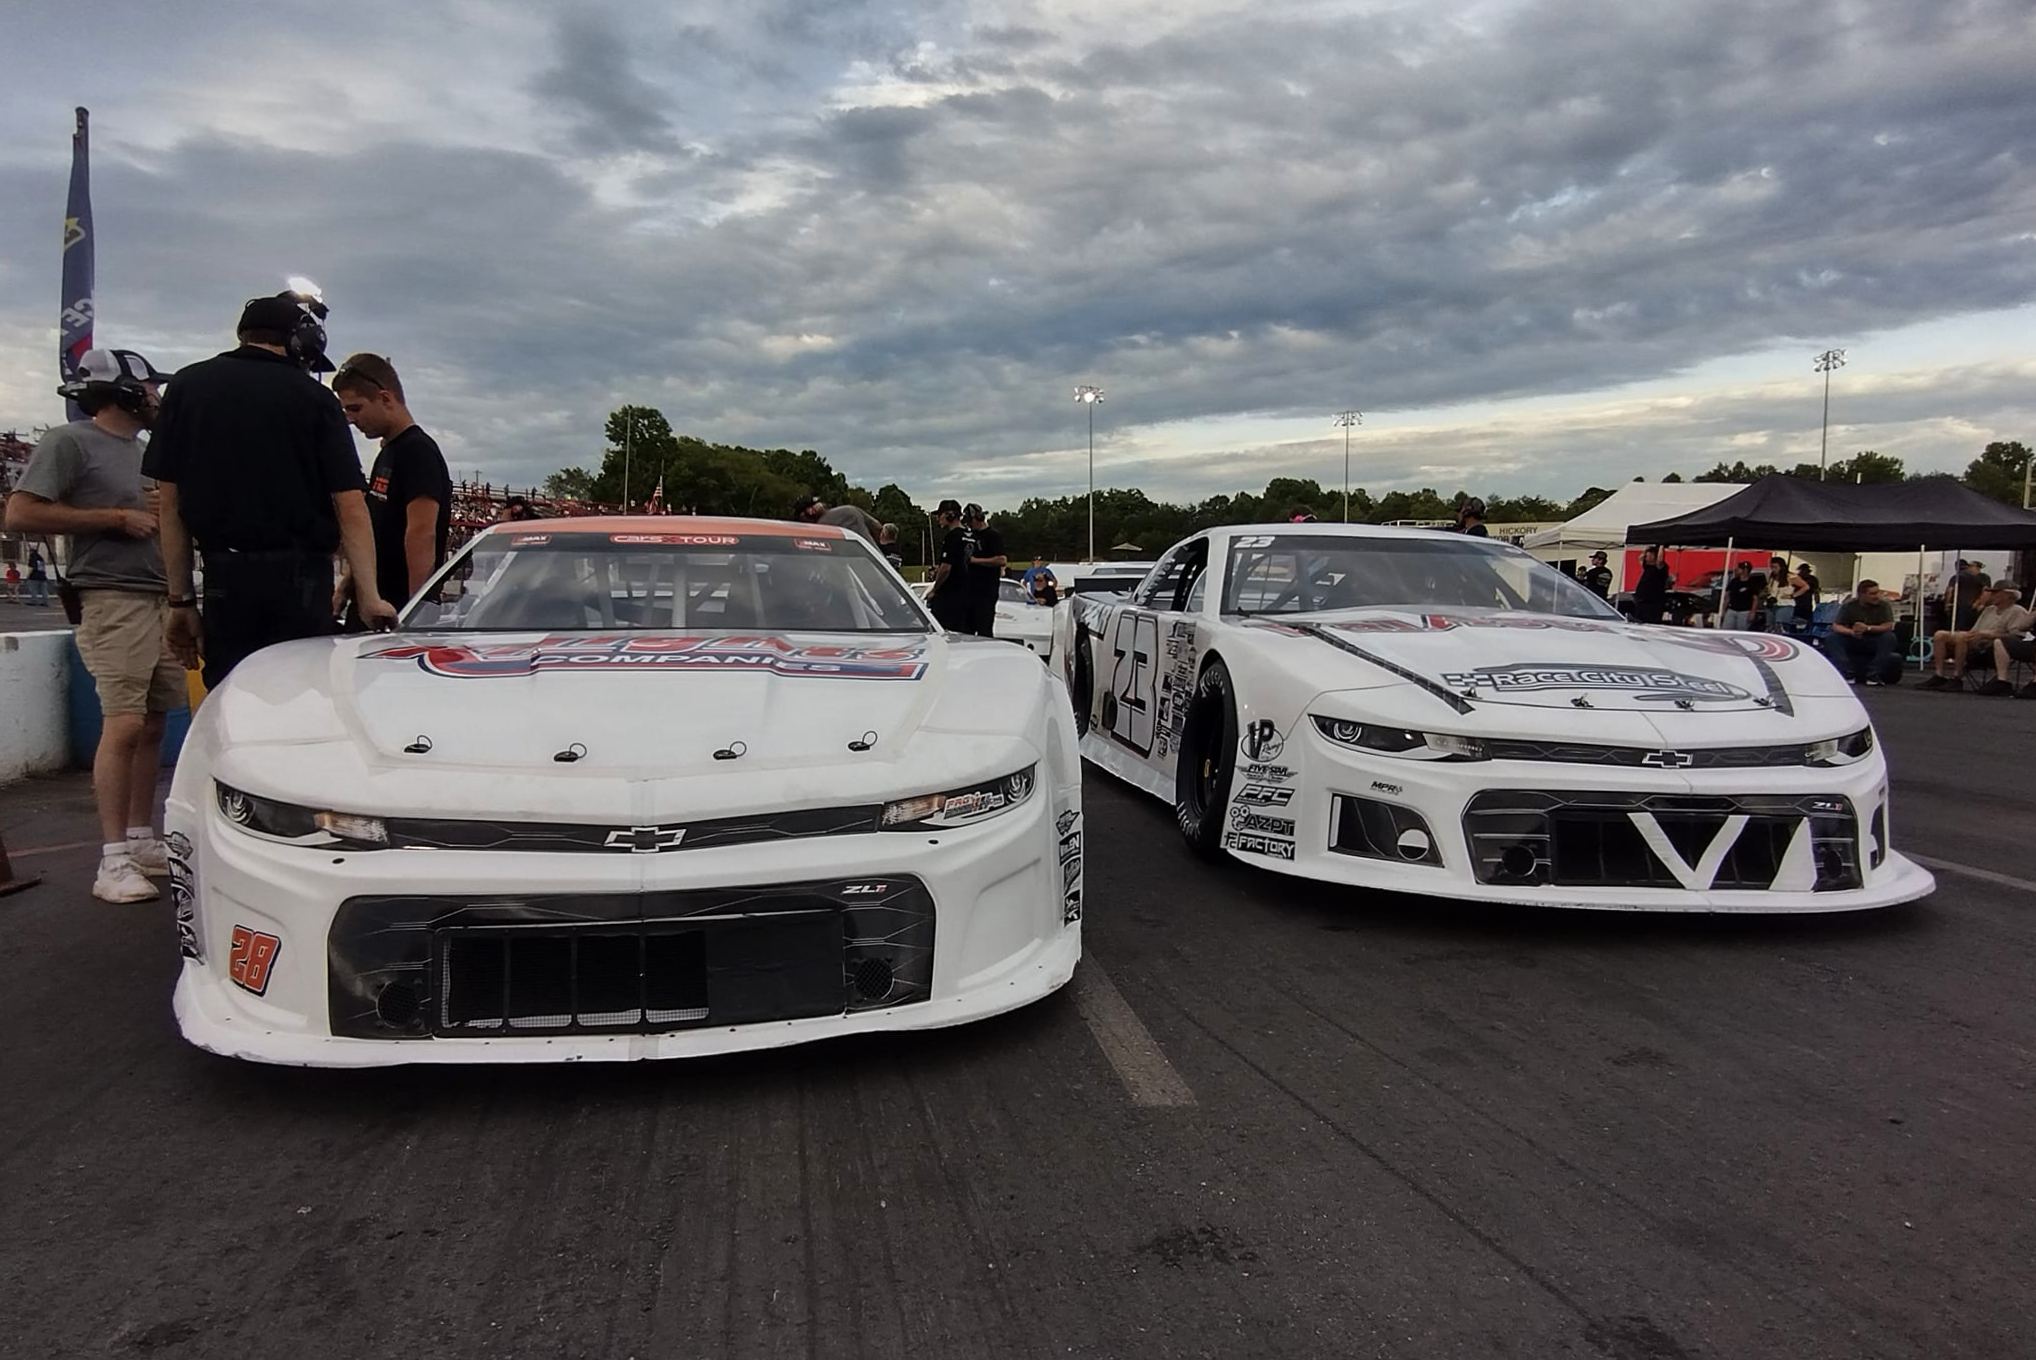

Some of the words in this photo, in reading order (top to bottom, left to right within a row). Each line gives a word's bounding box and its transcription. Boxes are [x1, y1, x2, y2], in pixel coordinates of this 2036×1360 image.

[681, 535, 738, 545] TOUR
[1499, 526, 1538, 535] HICKORY
[1234, 536, 1276, 549] 23
[531, 653, 841, 673] COMPANIES
[1111, 610, 1158, 759] 23
[1495, 673, 1573, 685] Race
[1582, 671, 1643, 687] City
[1650, 674, 1728, 694] Steel
[1240, 785, 1294, 802] PFC
[1244, 814, 1295, 835] AZPT
[1239, 835, 1295, 858] FACTORY
[230, 924, 282, 997] 28
